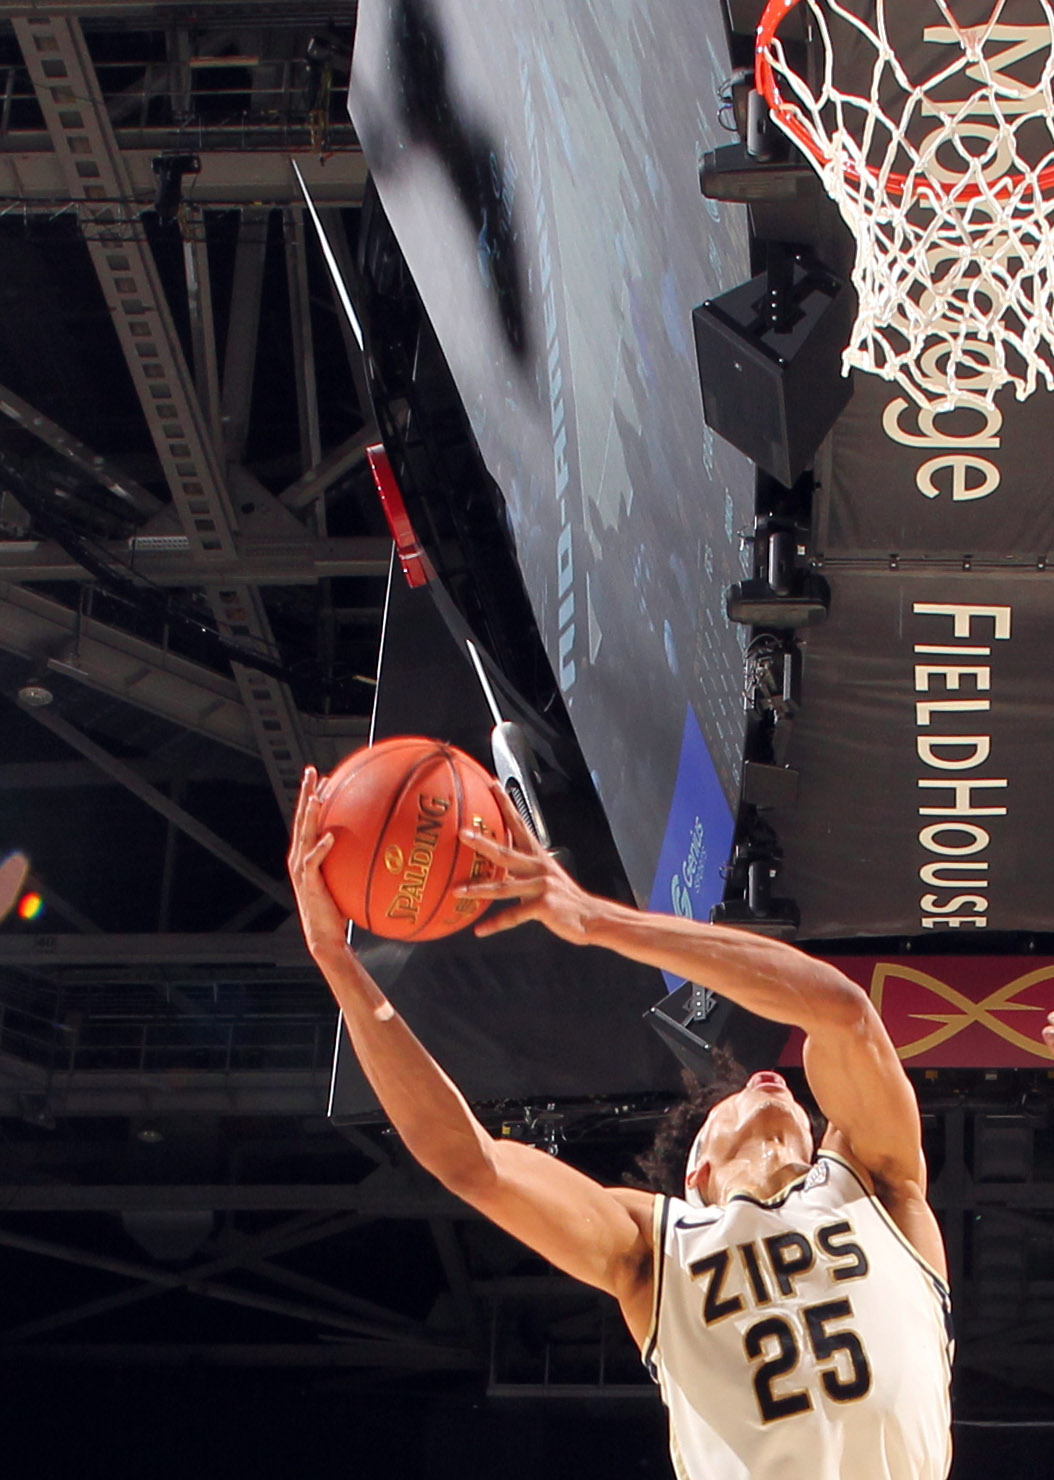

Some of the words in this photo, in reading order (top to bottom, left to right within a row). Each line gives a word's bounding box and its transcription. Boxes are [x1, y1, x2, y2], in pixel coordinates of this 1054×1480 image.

[912, 602, 1012, 929] FIELDHOUSE
[385, 794, 449, 924] SPALDING
[688, 1217, 870, 1327] ZIPS
[743, 1295, 874, 1426] 25
